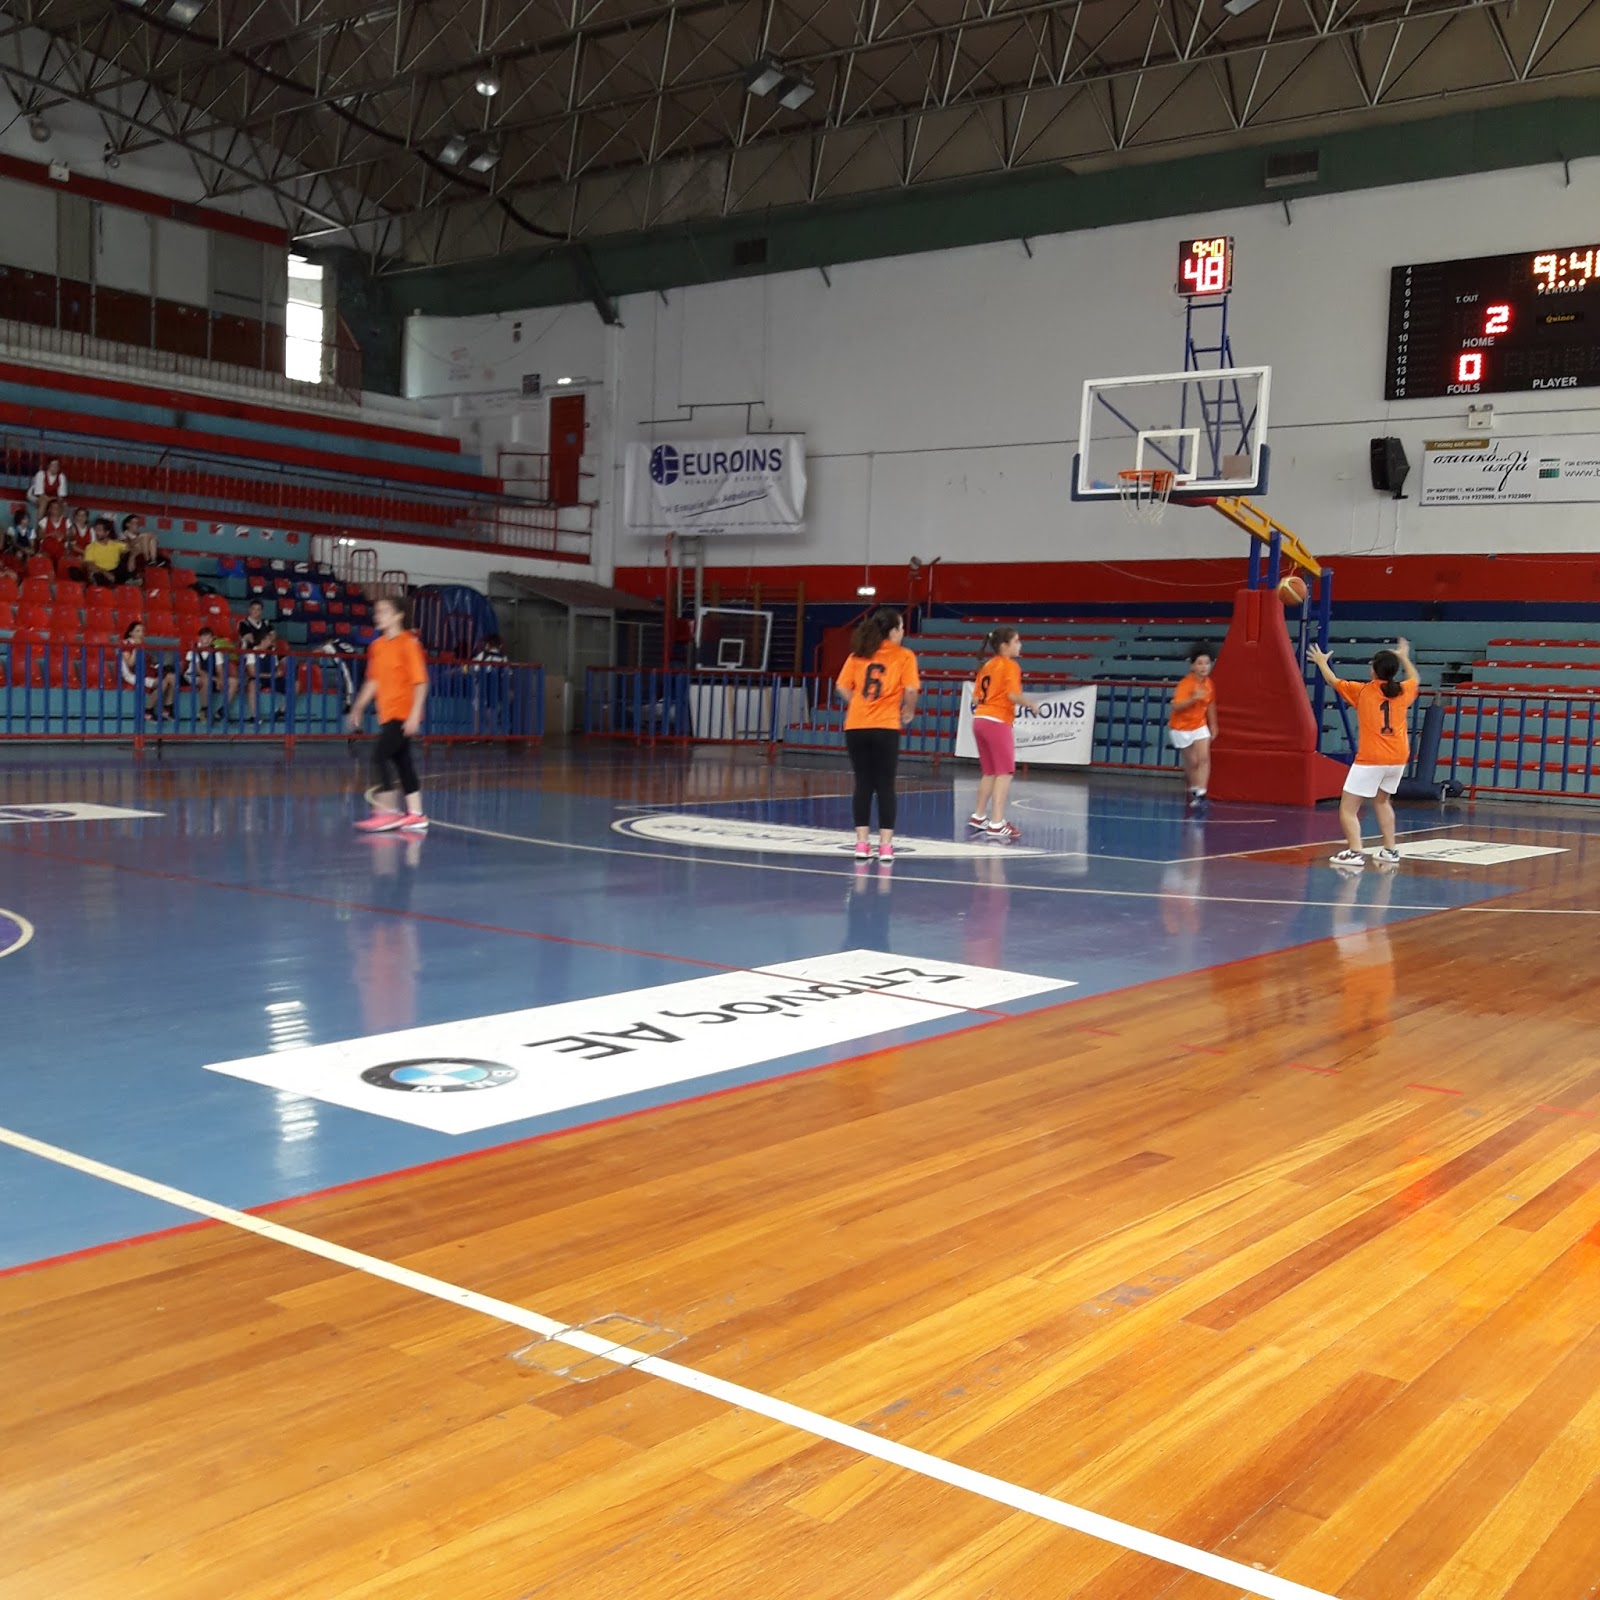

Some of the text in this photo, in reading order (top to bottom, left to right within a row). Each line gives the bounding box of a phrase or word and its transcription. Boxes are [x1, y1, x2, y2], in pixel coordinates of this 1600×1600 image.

[1184, 256, 1224, 291] 48
[1404, 299, 1410, 308] 7
[1463, 294, 1479, 303] OUT
[1485, 305, 1509, 333] 2
[1397, 333, 1409, 343] 10
[1462, 337, 1495, 348] HOME
[1397, 344, 1408, 353] 11
[1396, 355, 1407, 364] 12
[1396, 366, 1407, 375] 13
[1458, 353, 1482, 381] 0
[1395, 377, 1406, 386] 14
[1532, 376, 1578, 389] PLAYER
[1394, 388, 1405, 397] 15
[1446, 383, 1480, 395] FOULS
[683, 448, 783, 476] EUROINS
[861, 662, 887, 701] 6
[1014, 700, 1085, 720] UROINS
[1378, 699, 1394, 736] 1
[657, 965, 967, 1024] Σπανός
